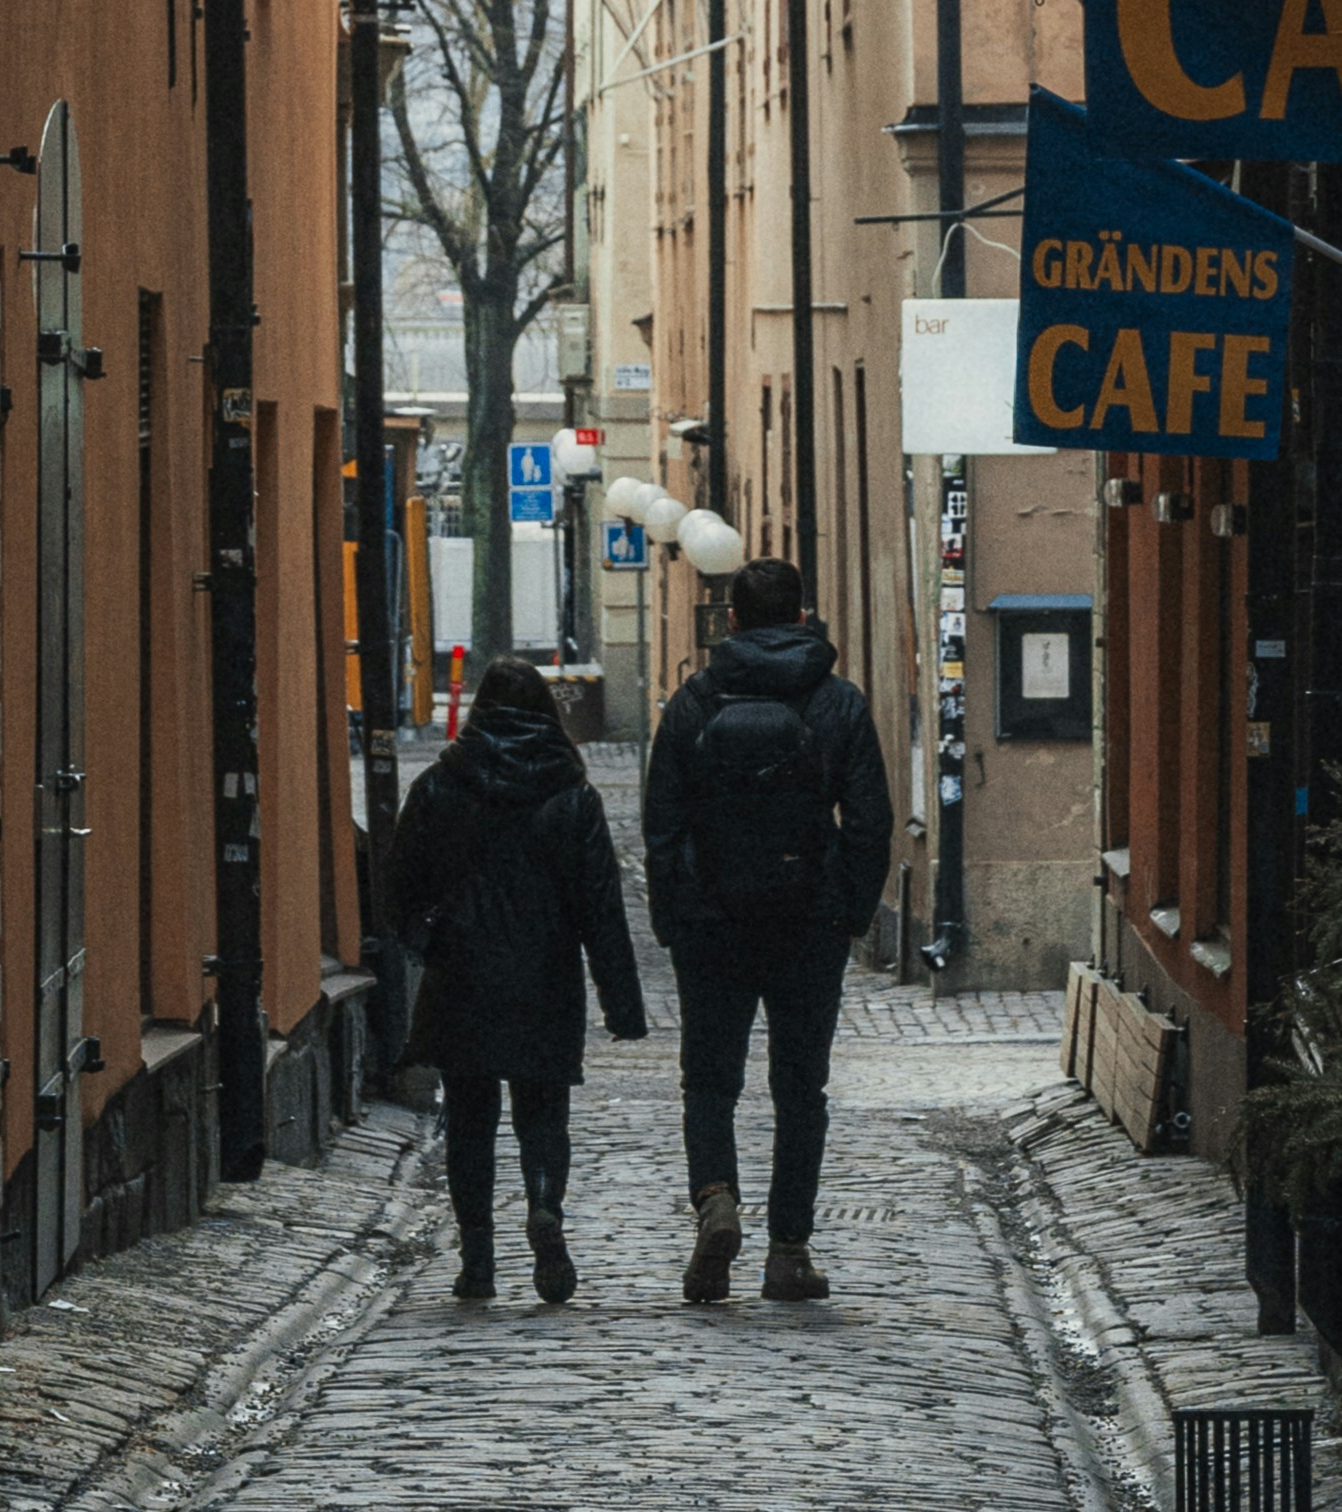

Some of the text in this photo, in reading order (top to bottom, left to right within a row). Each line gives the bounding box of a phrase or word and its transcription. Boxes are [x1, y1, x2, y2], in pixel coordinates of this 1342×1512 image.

[1032, 231, 1280, 300] GRÄNDENS
[914, 313, 950, 335] bar
[1027, 323, 1269, 439] CAFE
